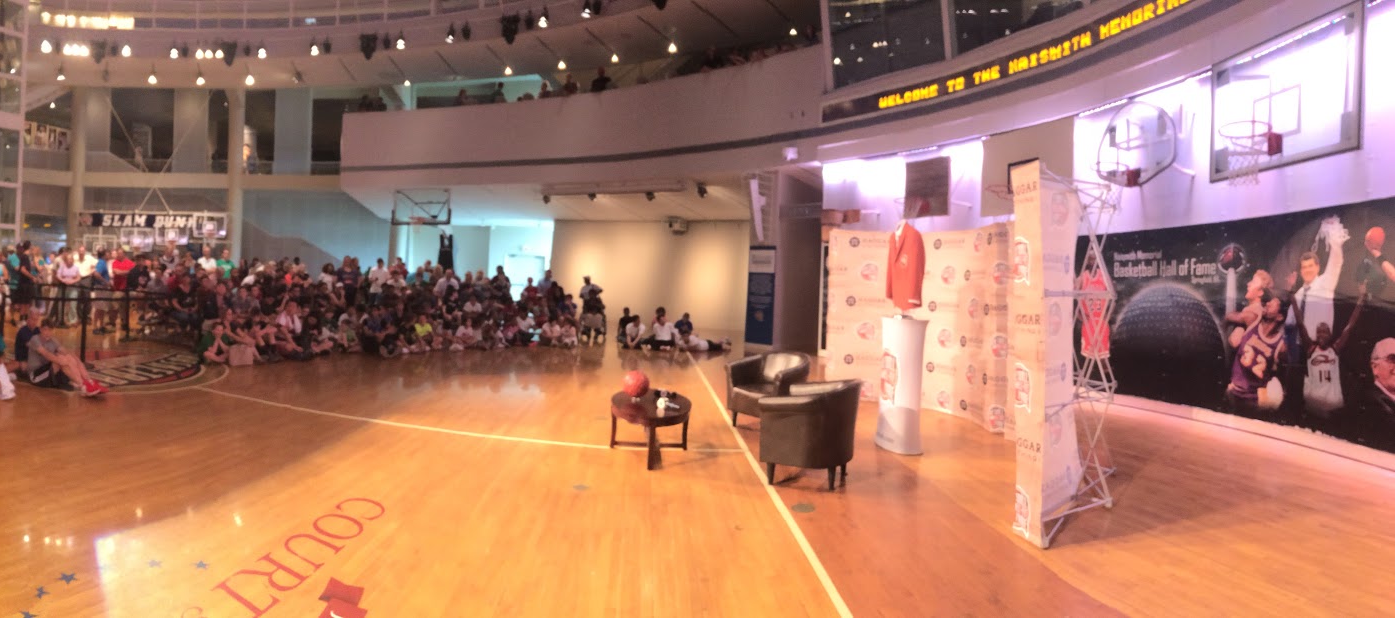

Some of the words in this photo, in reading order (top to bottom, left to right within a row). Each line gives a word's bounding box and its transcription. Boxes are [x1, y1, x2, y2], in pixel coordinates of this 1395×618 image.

[878, 84, 938, 109] WELCOME
[946, 76, 965, 93] TO
[973, 65, 1001, 85] THE
[1008, 31, 1092, 75] NAISMITH
[1099, 0, 1189, 40] MEMORIA
[102, 214, 147, 227] SLAM
[1114, 261, 1157, 277] Basketball
[1160, 259, 1176, 277] Hall
[1178, 258, 1189, 276] of
[1190, 257, 1217, 276] Fame
[1240, 344, 1267, 379] 32
[1318, 370, 1332, 383] 14
[210, 497, 386, 618] COURT
